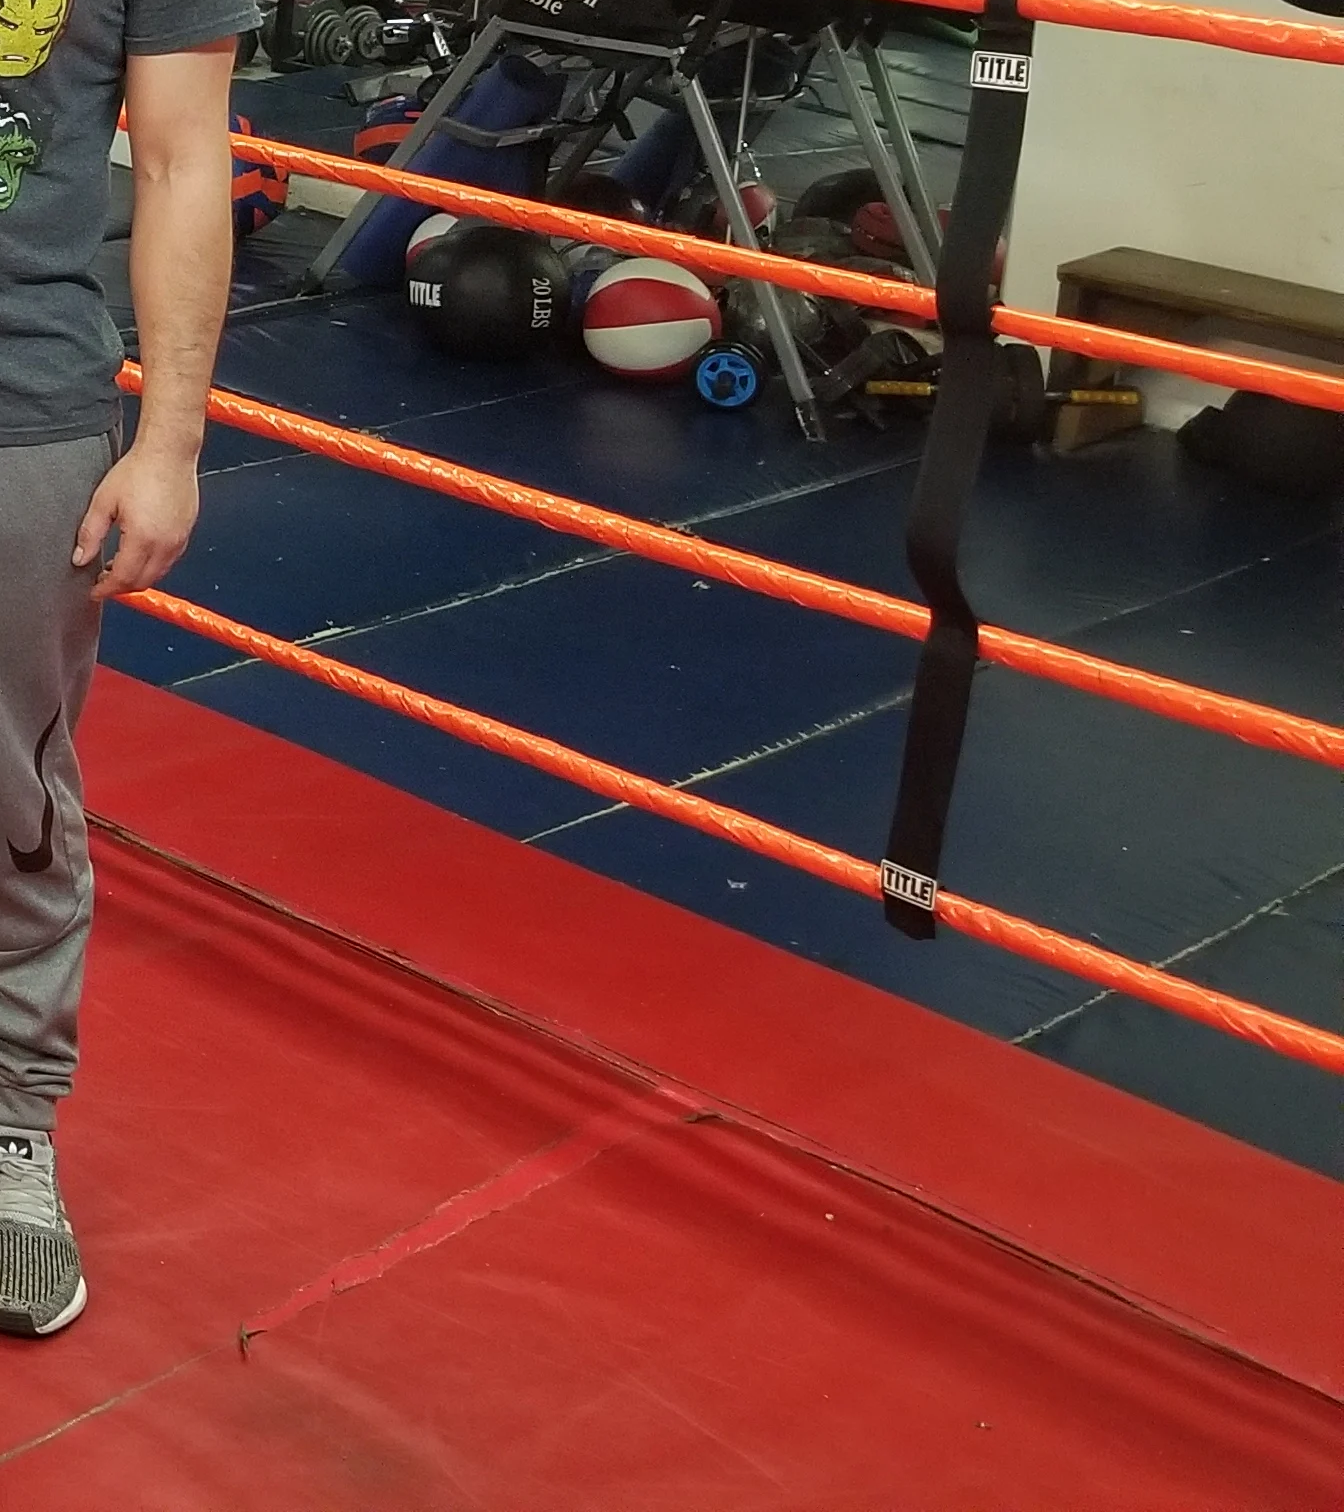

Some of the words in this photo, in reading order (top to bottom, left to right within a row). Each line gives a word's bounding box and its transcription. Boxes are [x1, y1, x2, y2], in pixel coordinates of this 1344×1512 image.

[978, 56, 1026, 83] TITLE
[409, 279, 443, 308] TITLE
[532, 277, 552, 296] 20
[531, 298, 553, 329] LBS
[885, 866, 933, 902] TITLE
